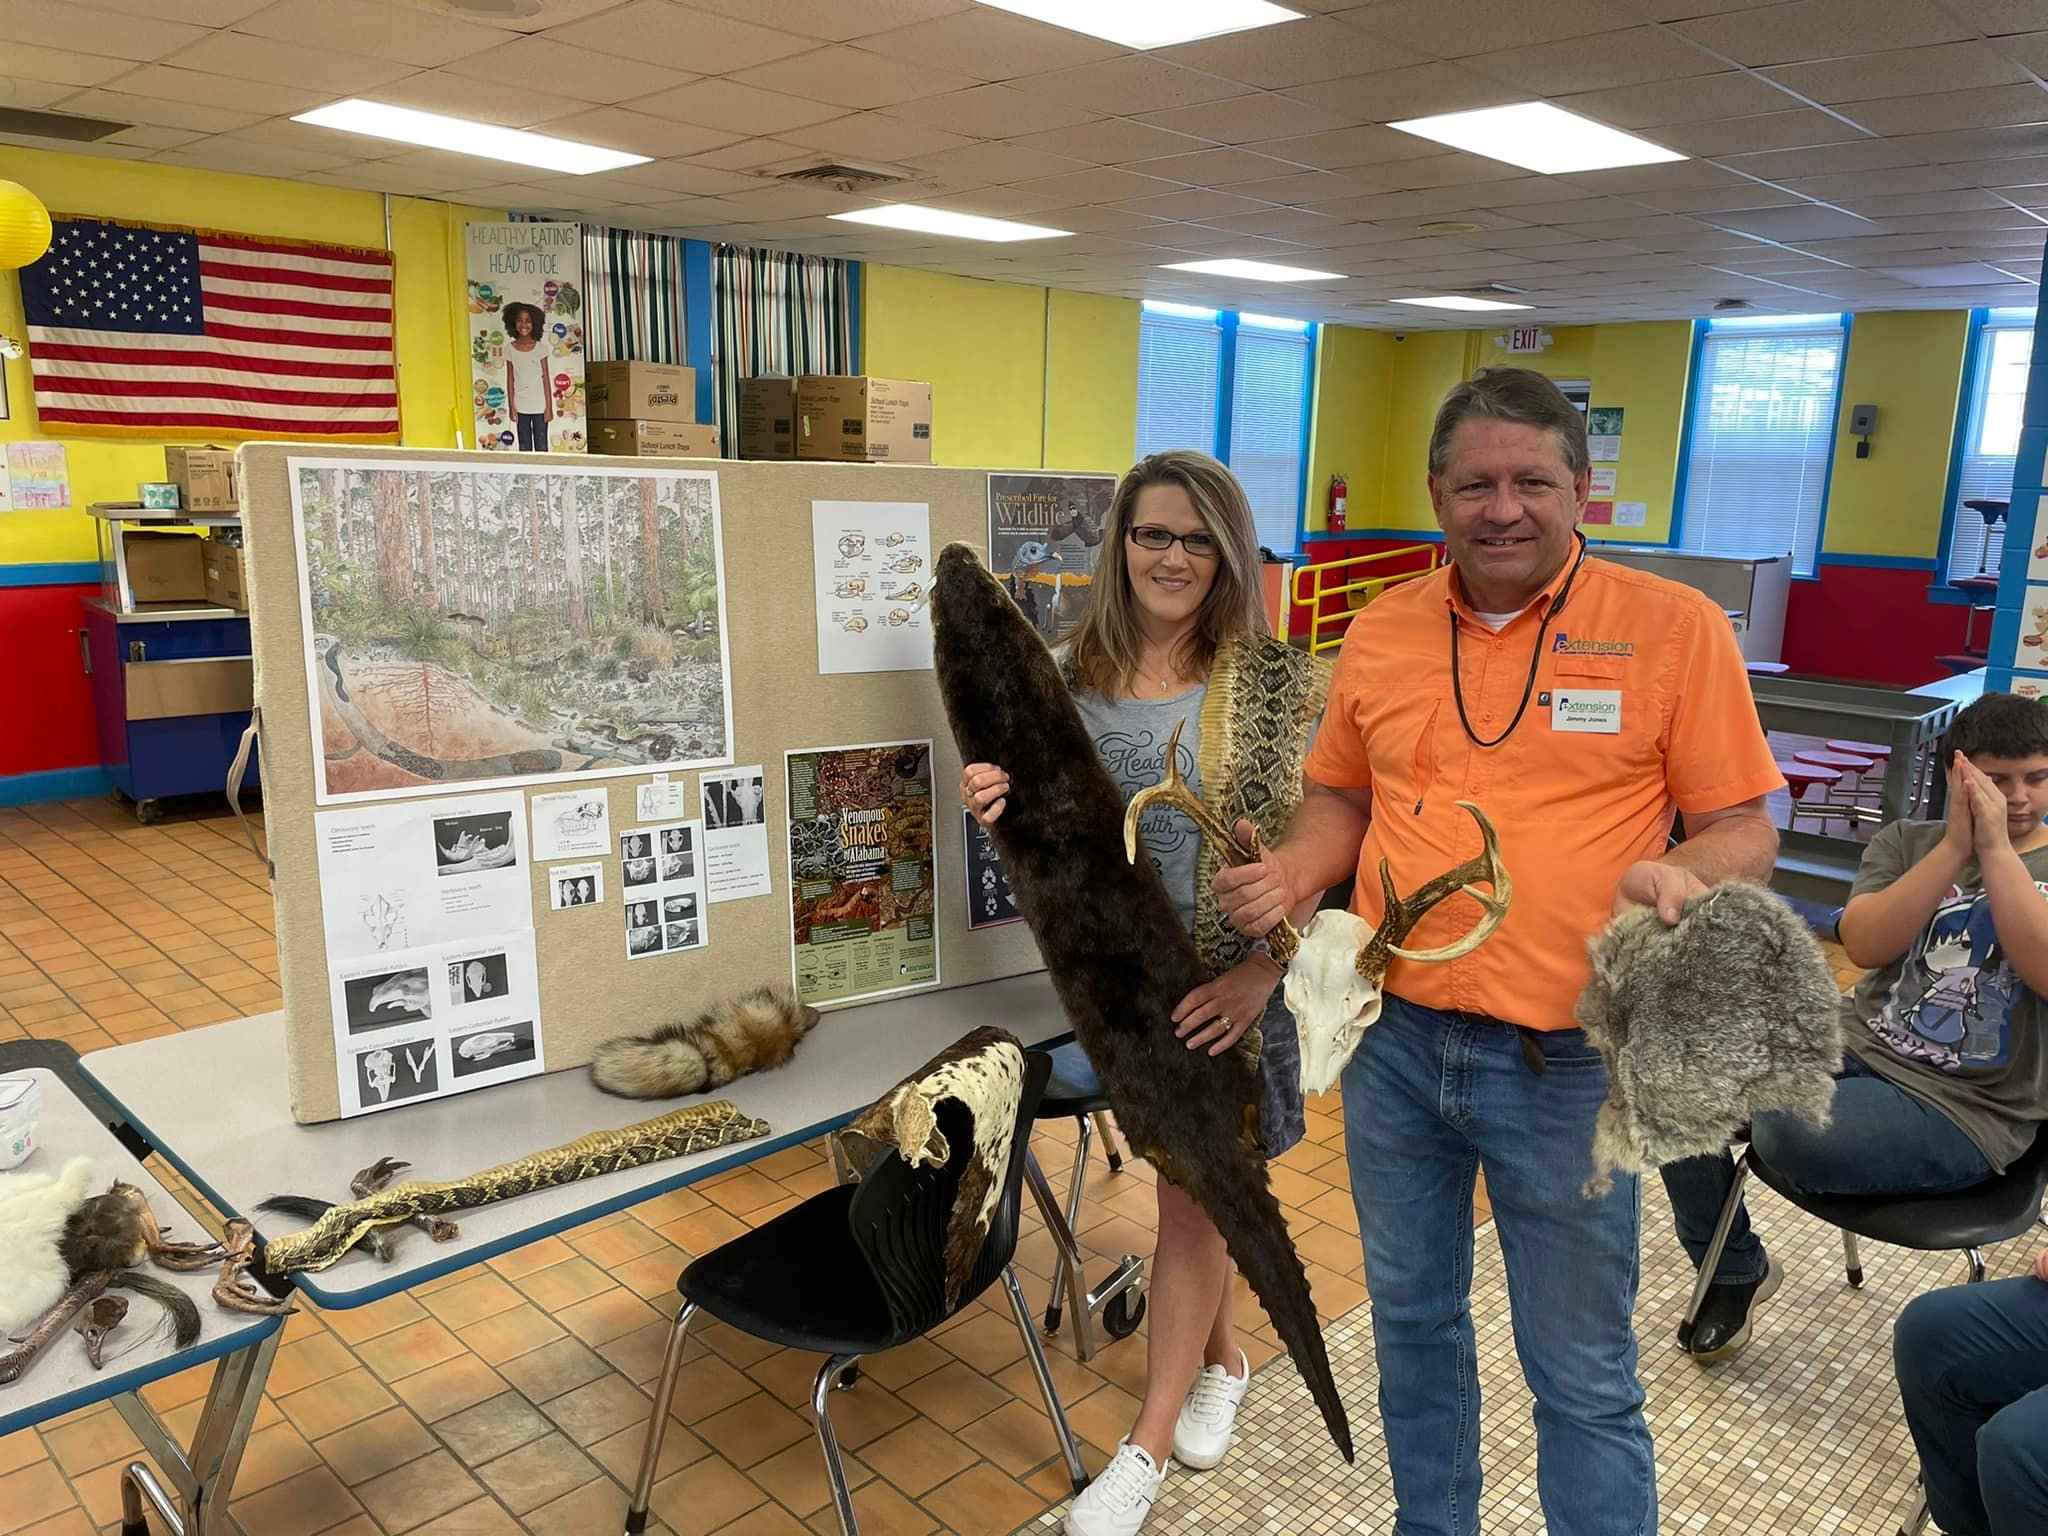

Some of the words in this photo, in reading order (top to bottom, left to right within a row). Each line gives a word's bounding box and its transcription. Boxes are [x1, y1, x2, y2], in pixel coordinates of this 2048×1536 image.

[472, 226, 527, 246] HEALTHY
[530, 227, 574, 246] EATING
[489, 253, 520, 274] HEAD
[538, 254, 560, 275] TOE
[1512, 328, 1539, 350] EXIT
[640, 441, 659, 449] School
[660, 442, 676, 450] Lunch
[995, 501, 1065, 526] Wildlife
[842, 807, 886, 825] Venomous
[841, 820, 888, 849] Snakes
[850, 845, 886, 863] Alabama
